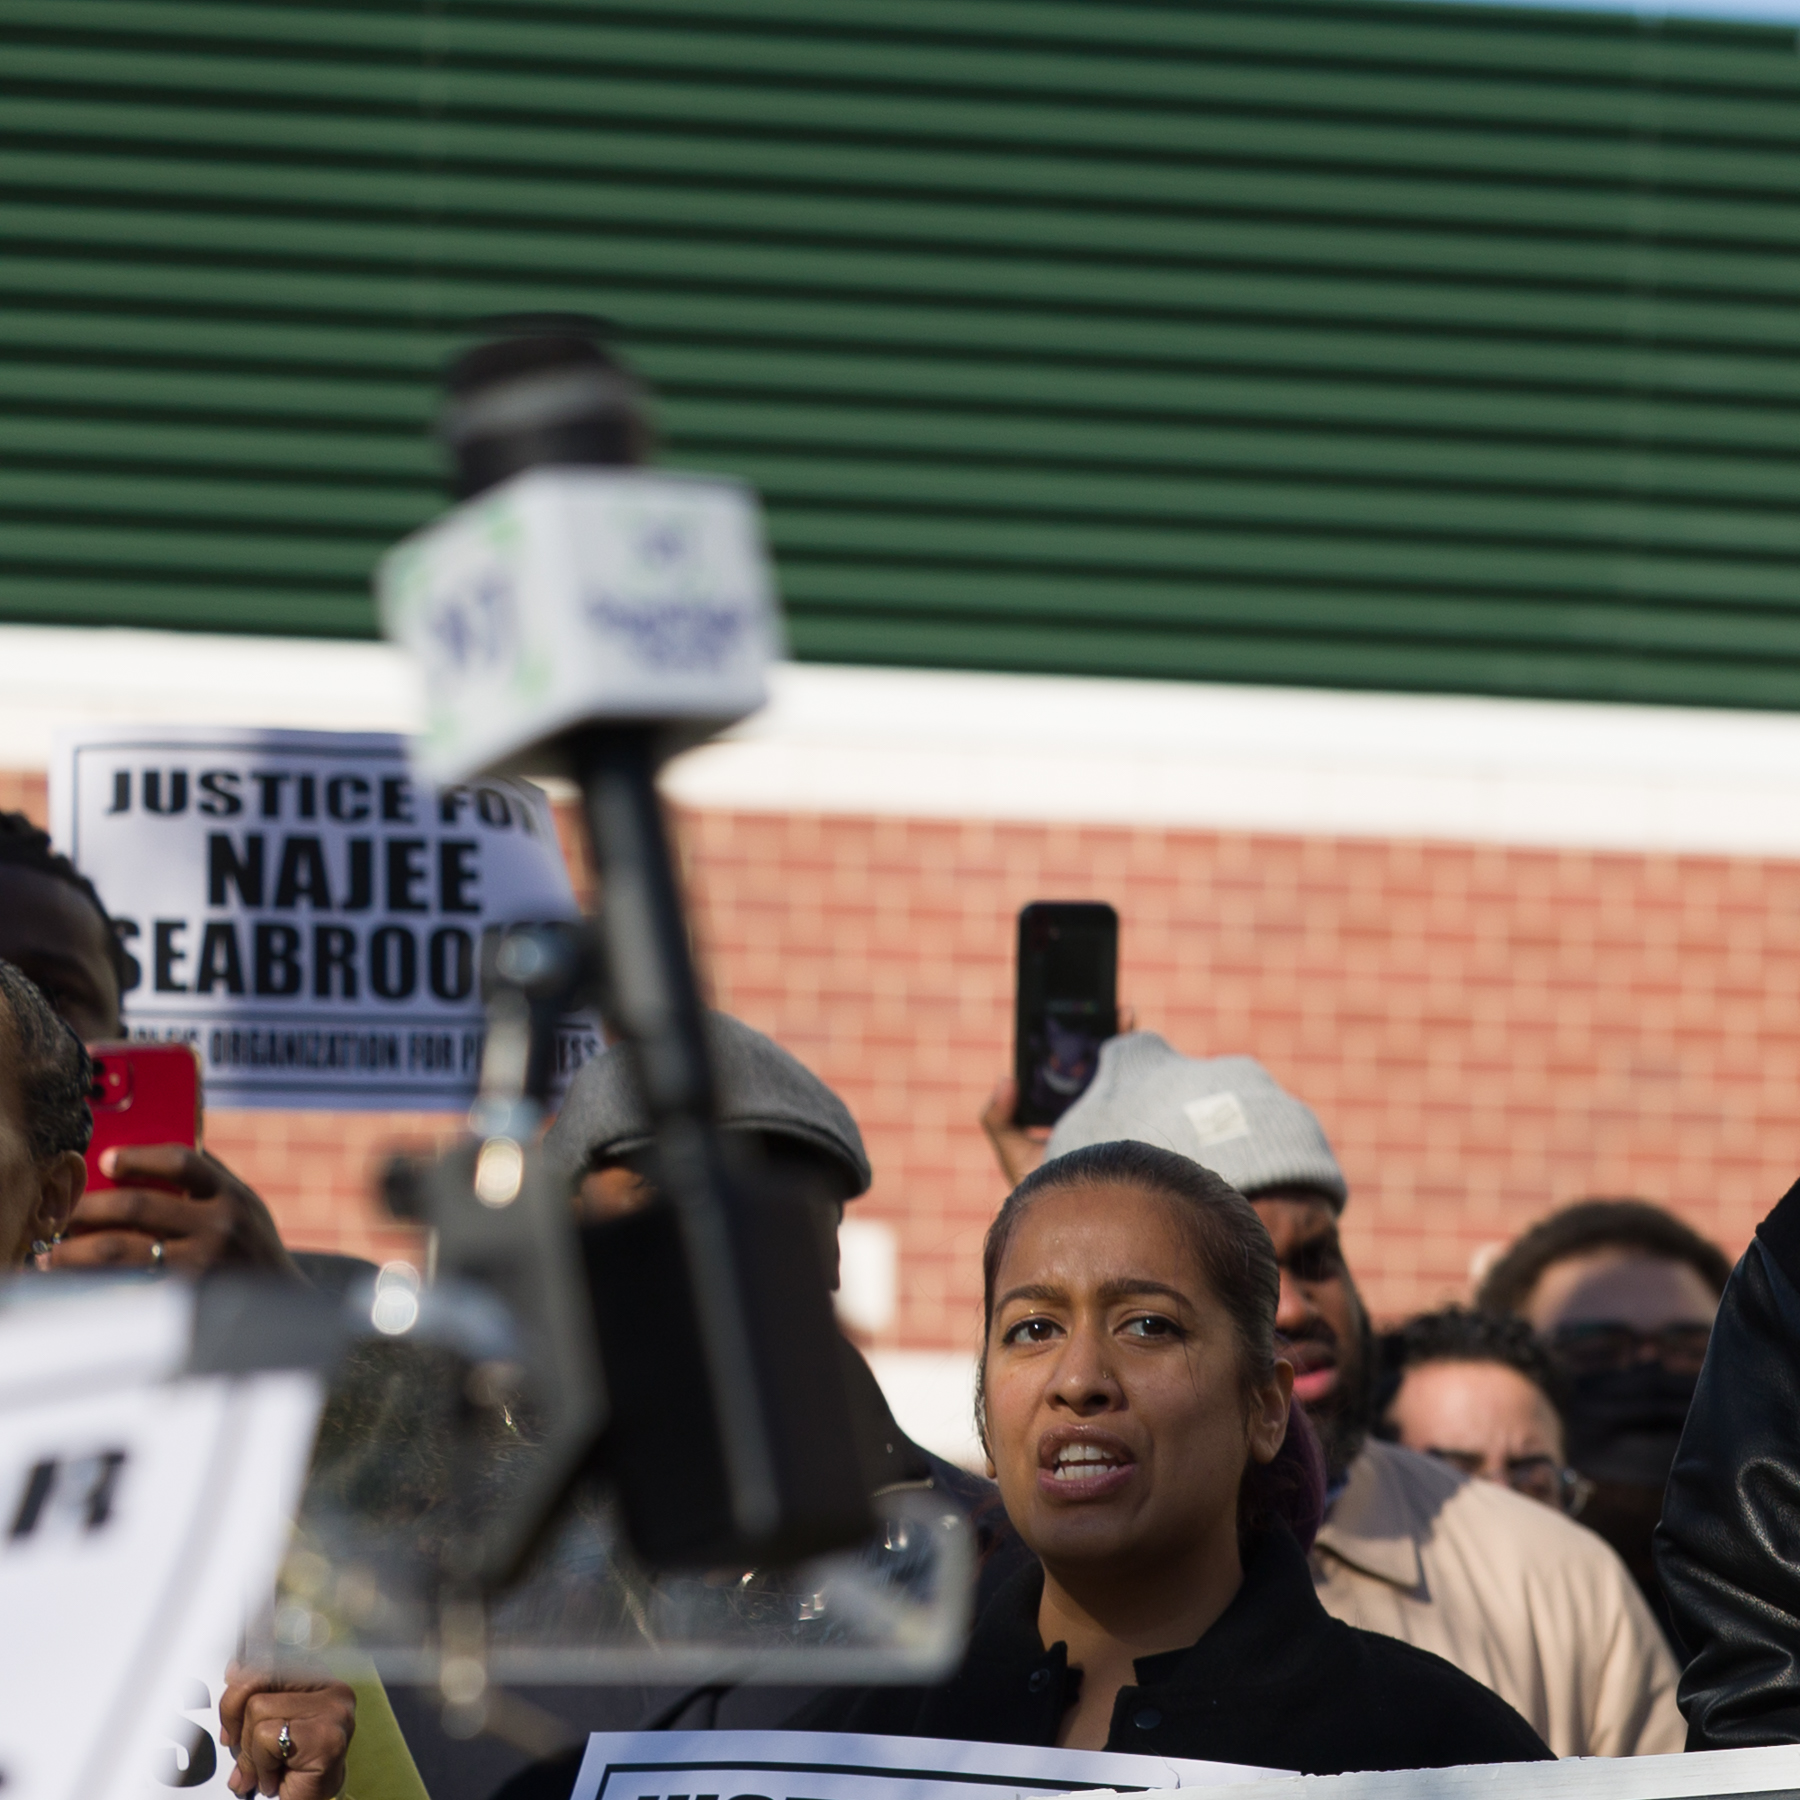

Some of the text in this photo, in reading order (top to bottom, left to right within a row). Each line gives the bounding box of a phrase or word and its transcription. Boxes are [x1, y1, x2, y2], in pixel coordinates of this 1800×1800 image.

[107, 767, 413, 826] JUSTICE
[207, 832, 483, 912] NAJEE
[210, 1028, 398, 1072] ORGANIZATION
[410, 1031, 456, 1074] FOR
